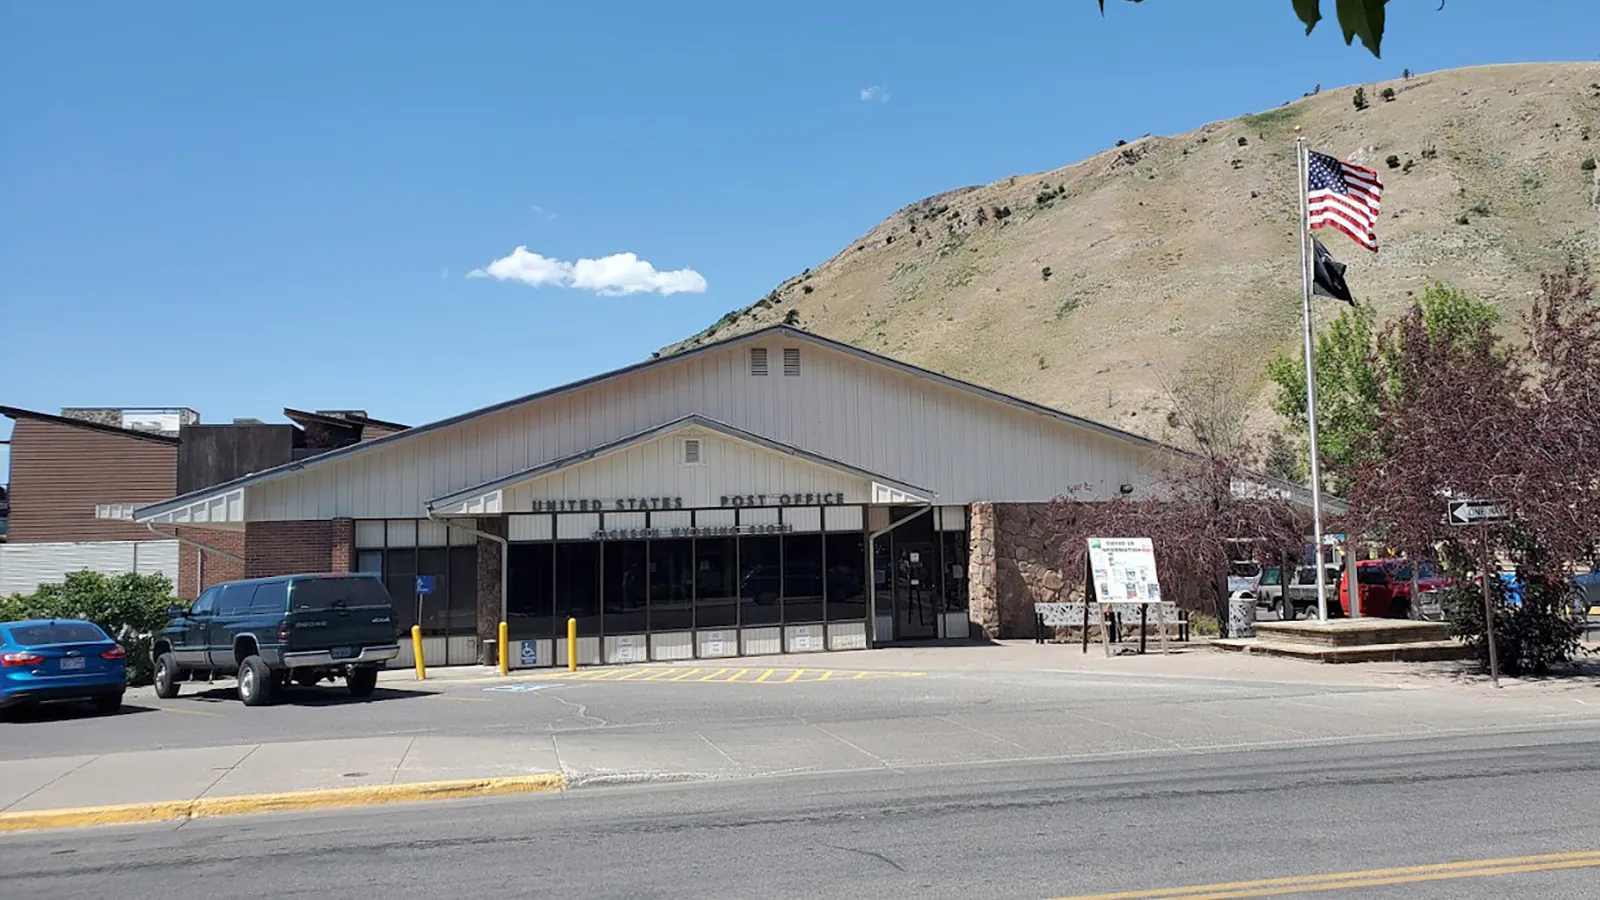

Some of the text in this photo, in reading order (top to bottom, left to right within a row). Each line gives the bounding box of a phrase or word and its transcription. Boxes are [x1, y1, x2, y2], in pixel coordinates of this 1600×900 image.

[532, 493, 844, 511] UNITED STATES POST OFFICE
[592, 528, 659, 539] JACKSON
[671, 526, 739, 537] WYOMING
